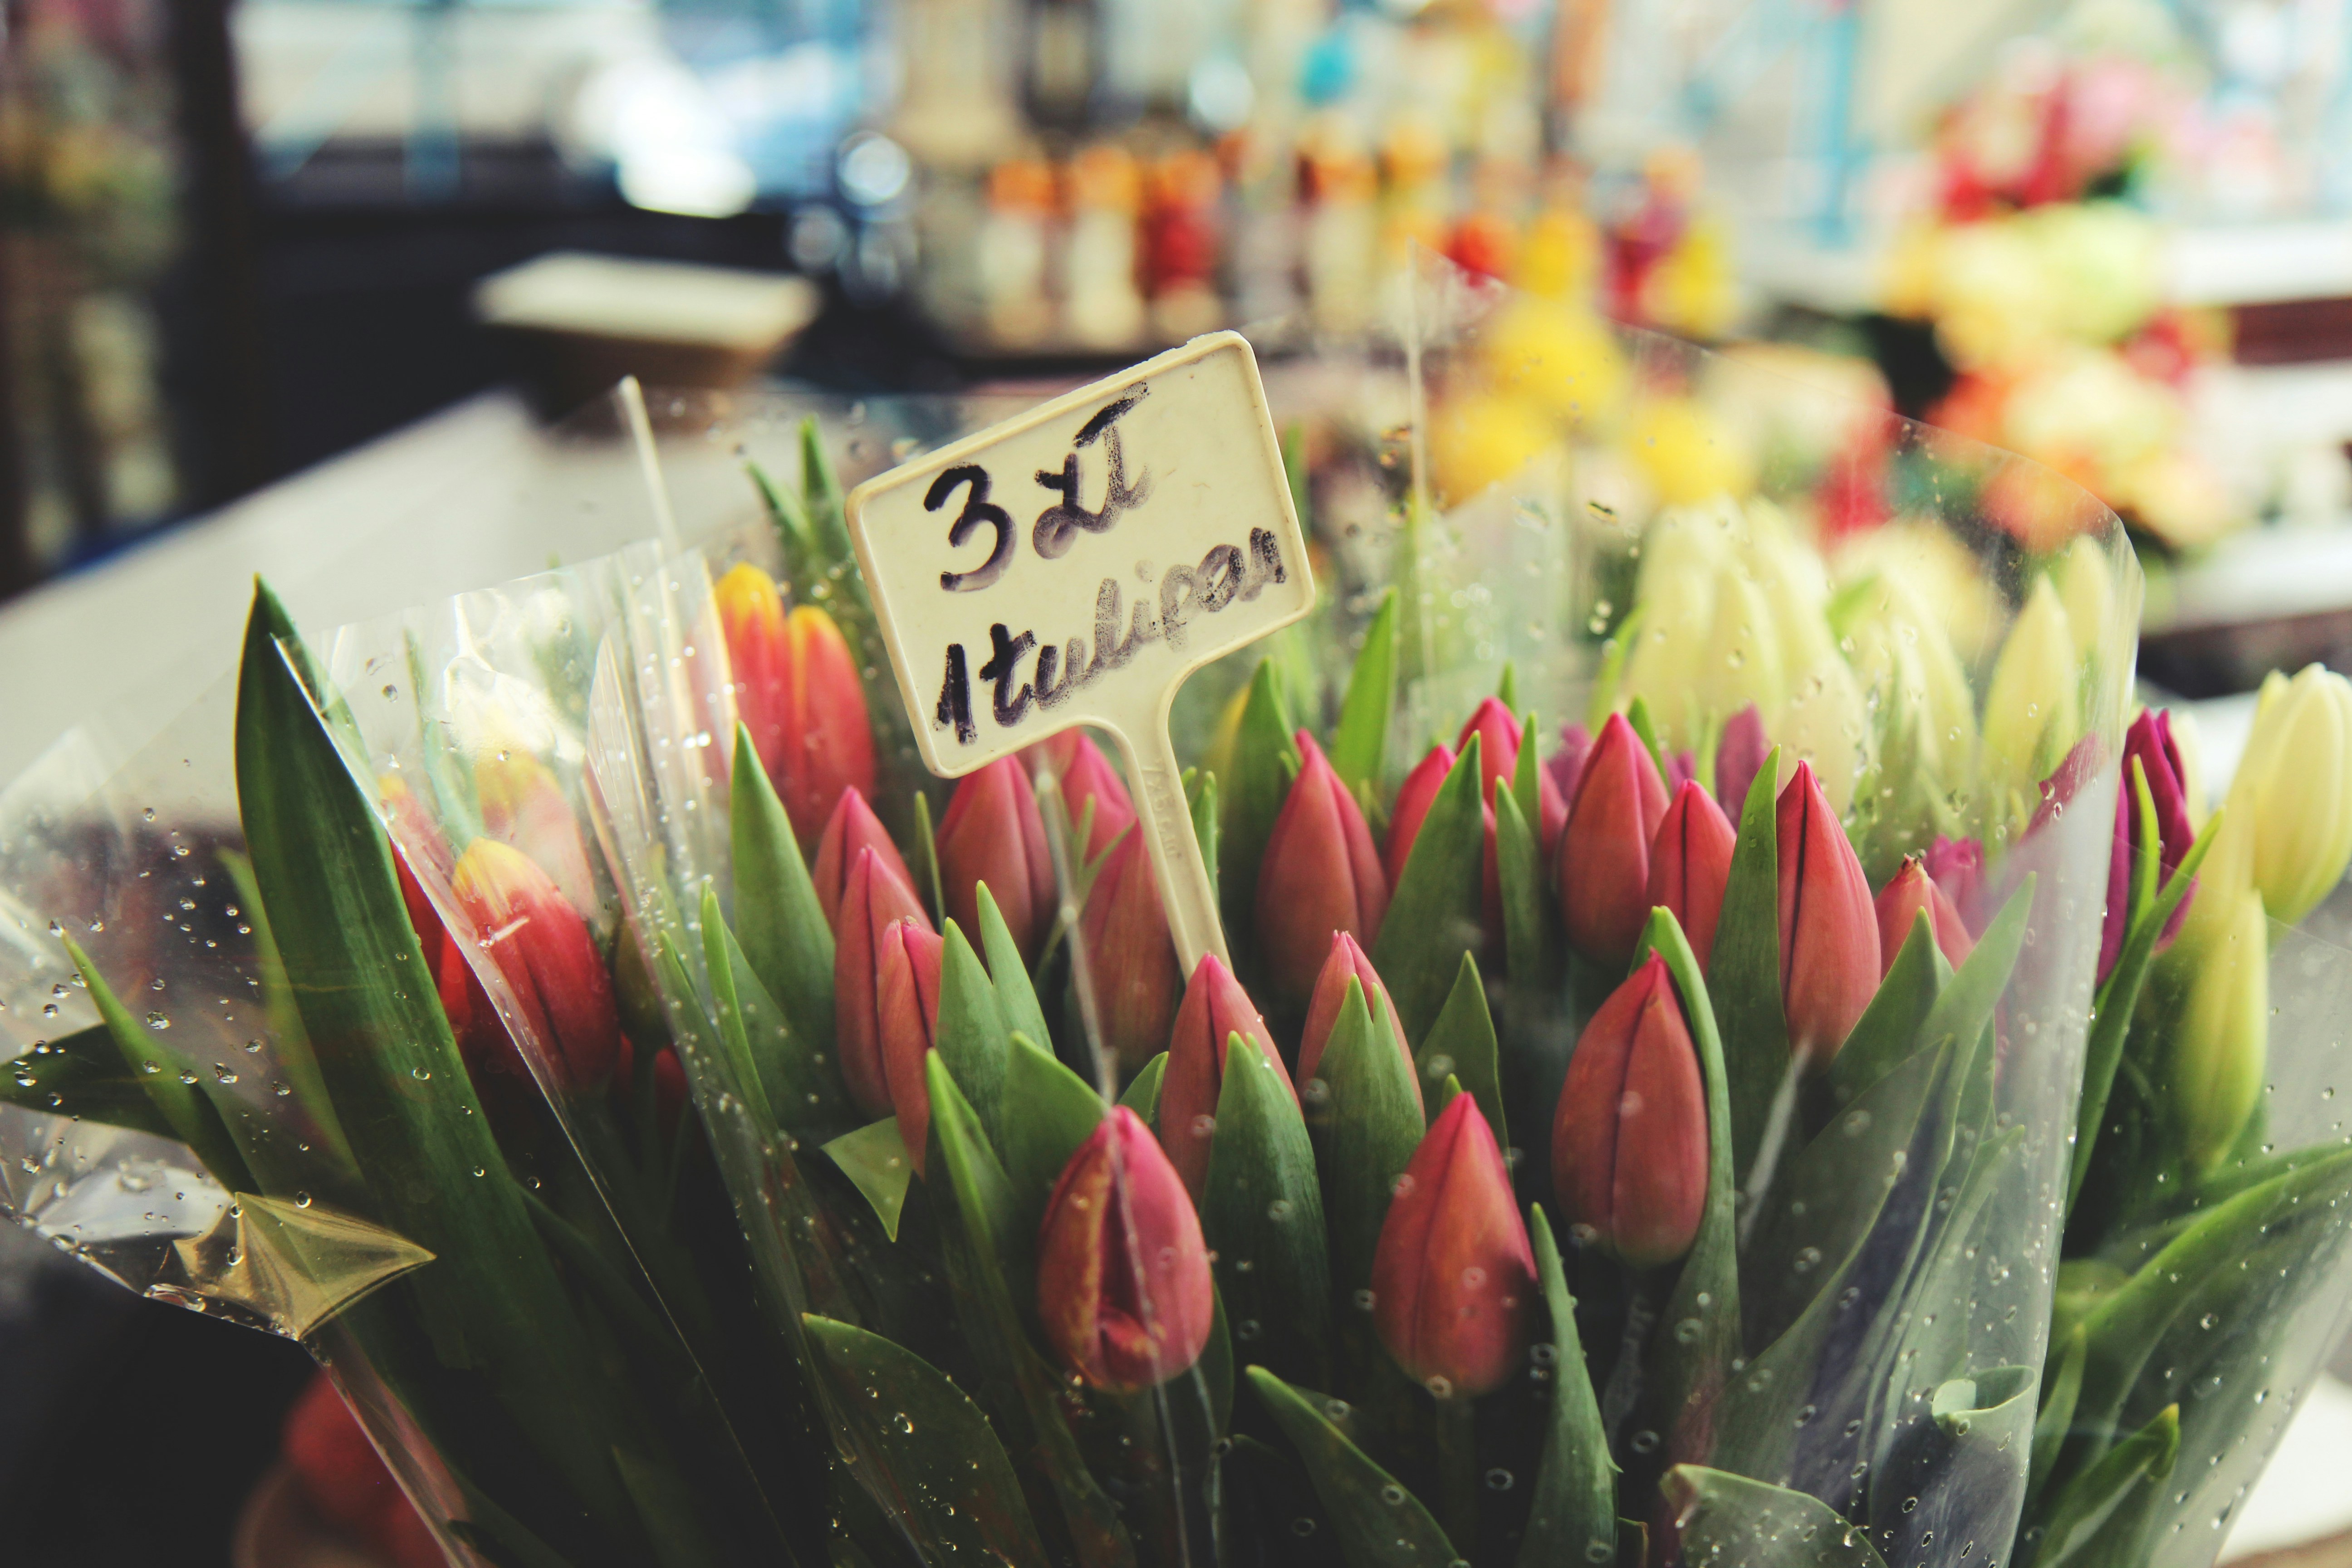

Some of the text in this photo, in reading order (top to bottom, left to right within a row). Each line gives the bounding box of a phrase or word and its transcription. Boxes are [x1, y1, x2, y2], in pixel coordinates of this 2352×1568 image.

[924, 463, 1016, 591] 3
[933, 527, 1288, 745] 1 tulipan
